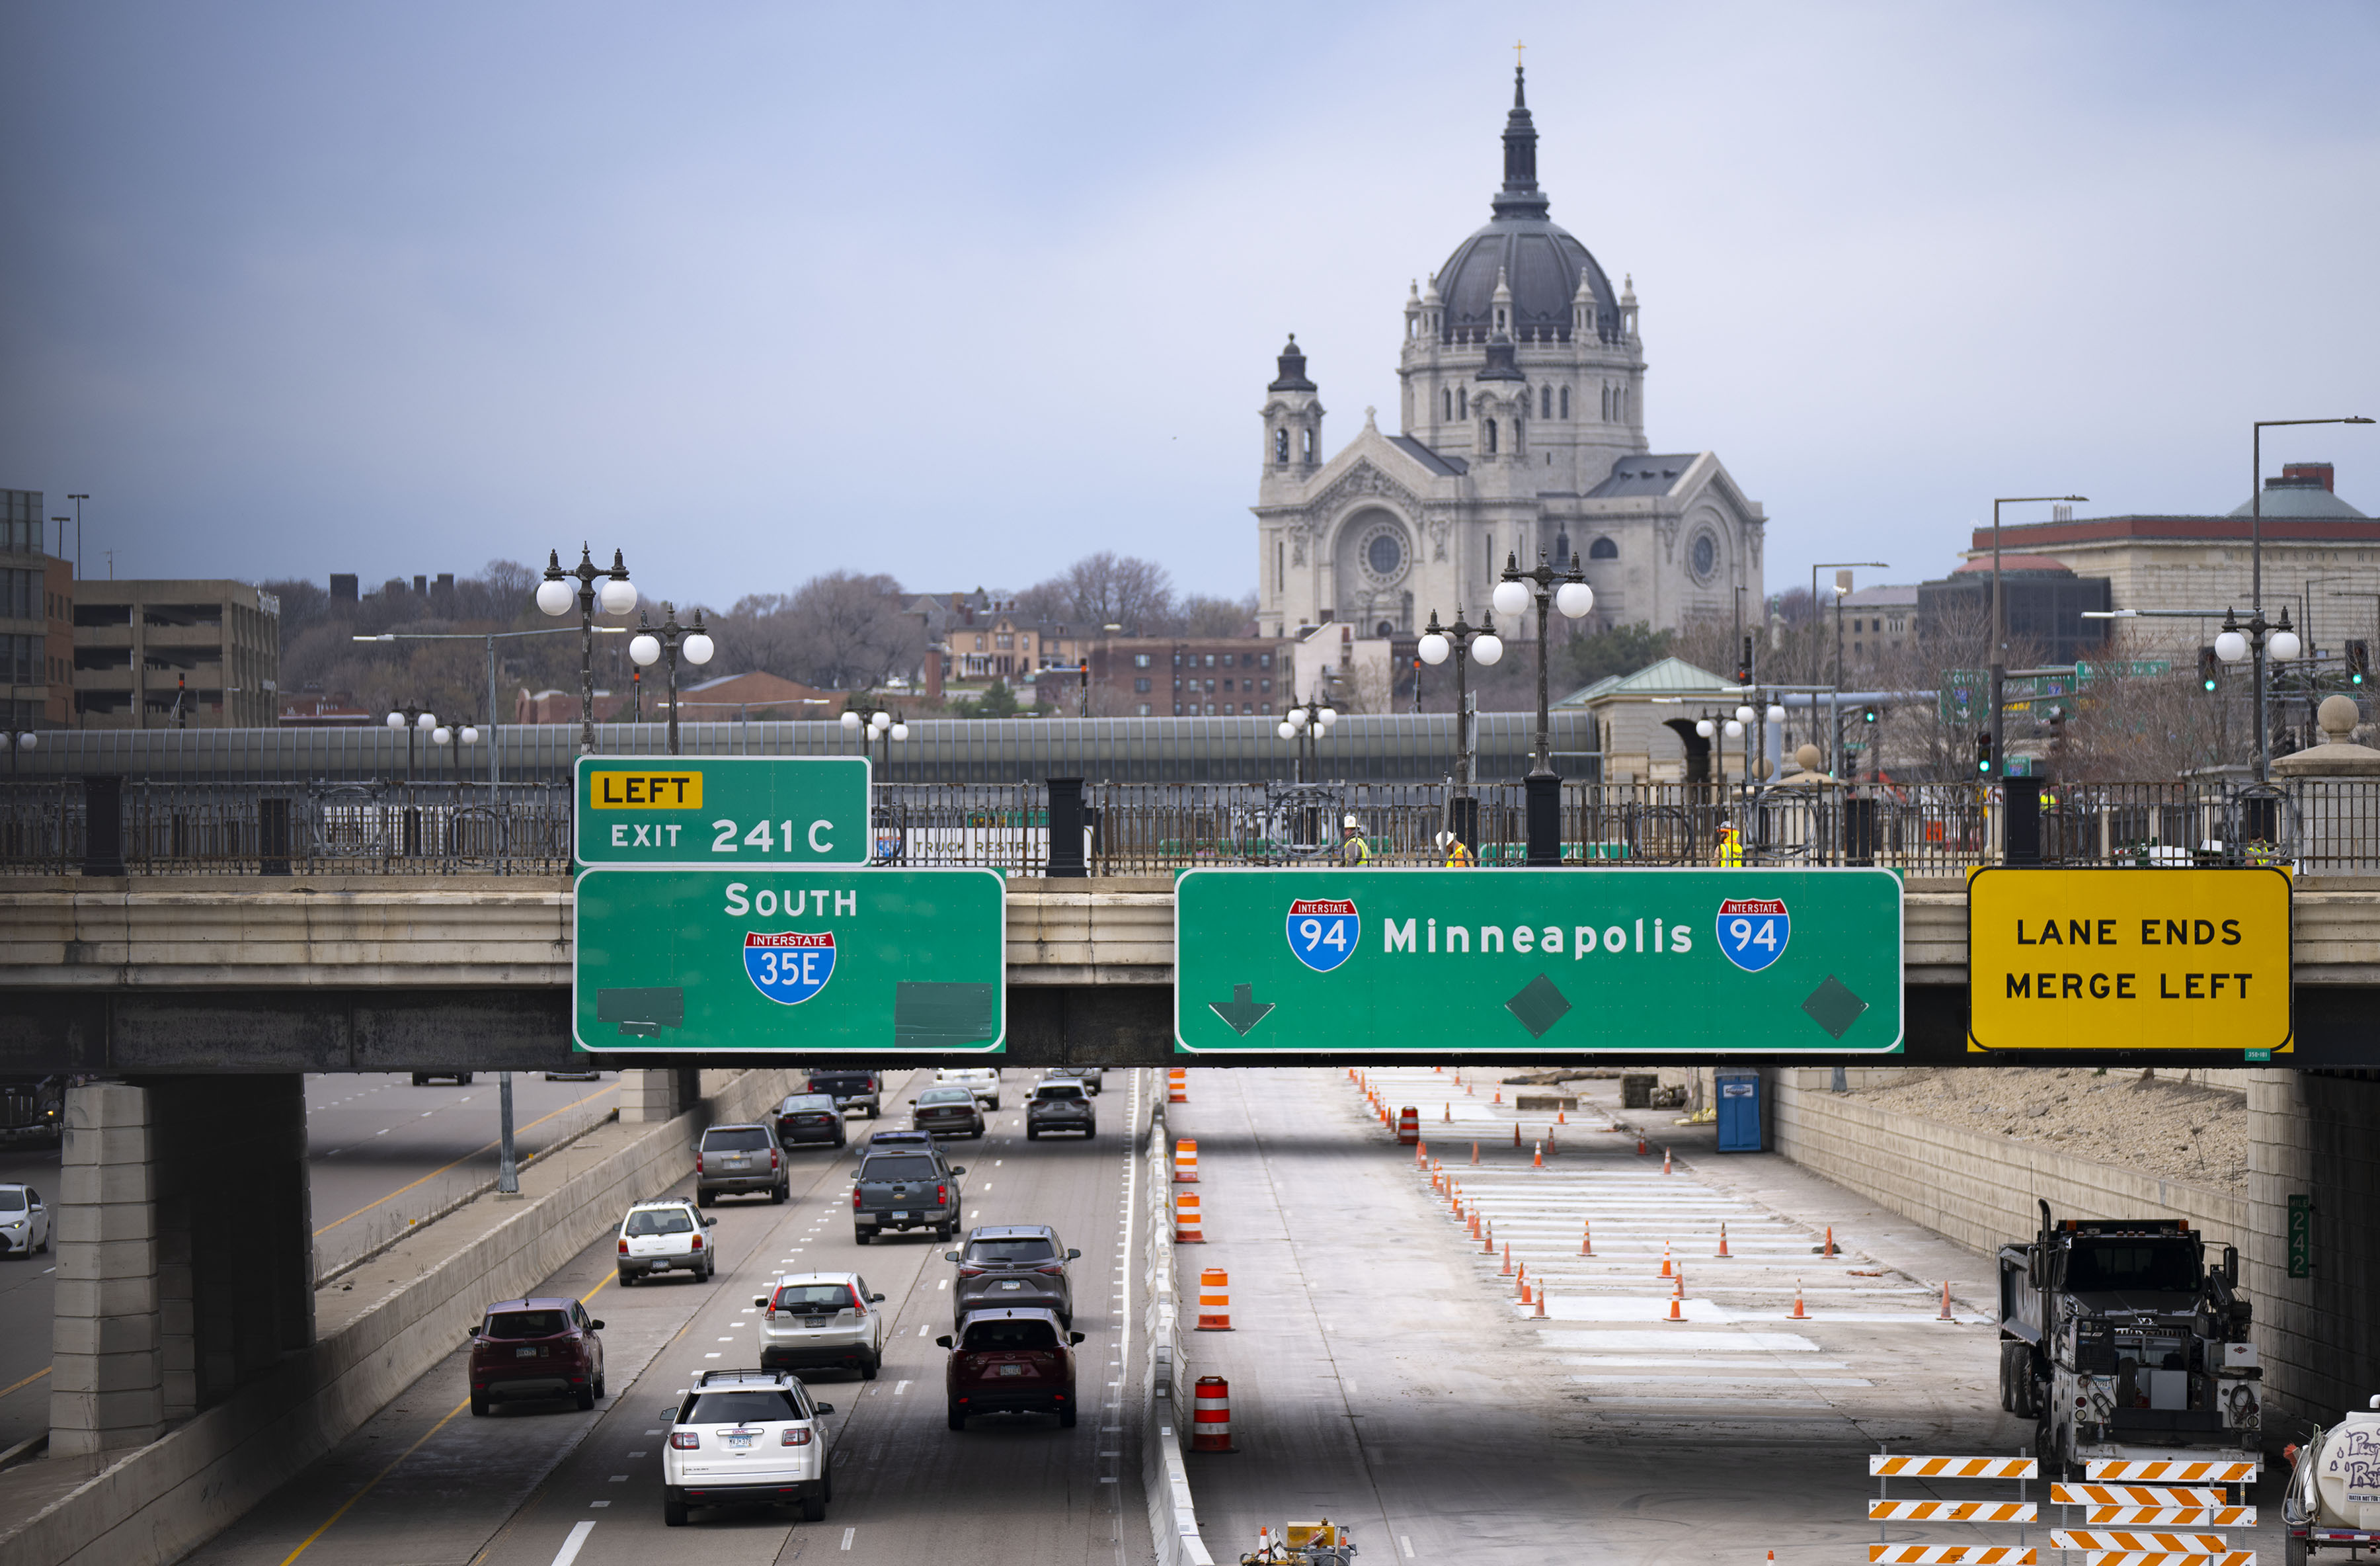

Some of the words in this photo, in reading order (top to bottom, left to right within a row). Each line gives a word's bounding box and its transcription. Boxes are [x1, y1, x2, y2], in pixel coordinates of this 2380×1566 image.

[2225, 550, 2339, 561] MINESOTA
[604, 777, 690, 803] LEFT
[612, 825, 682, 847] EXIT
[916, 842, 965, 852] TRUCK
[724, 883, 856, 917] SOUTH
[1298, 904, 1348, 913] INTERSTATE
[1727, 903, 1778, 914] INTERSTATE
[752, 935, 827, 946] INTERSTATE
[1300, 919, 1347, 952] 94
[1384, 918, 1692, 960] Minneapolis
[1729, 919, 1777, 952] 94
[2018, 919, 2117, 945] LANE
[2141, 919, 2241, 946] ENDS
[760, 952, 820, 985] 35E
[2006, 973, 2136, 999] MERGE
[2161, 973, 2252, 999] LEFT
[2293, 1211, 2305, 1274] 242
